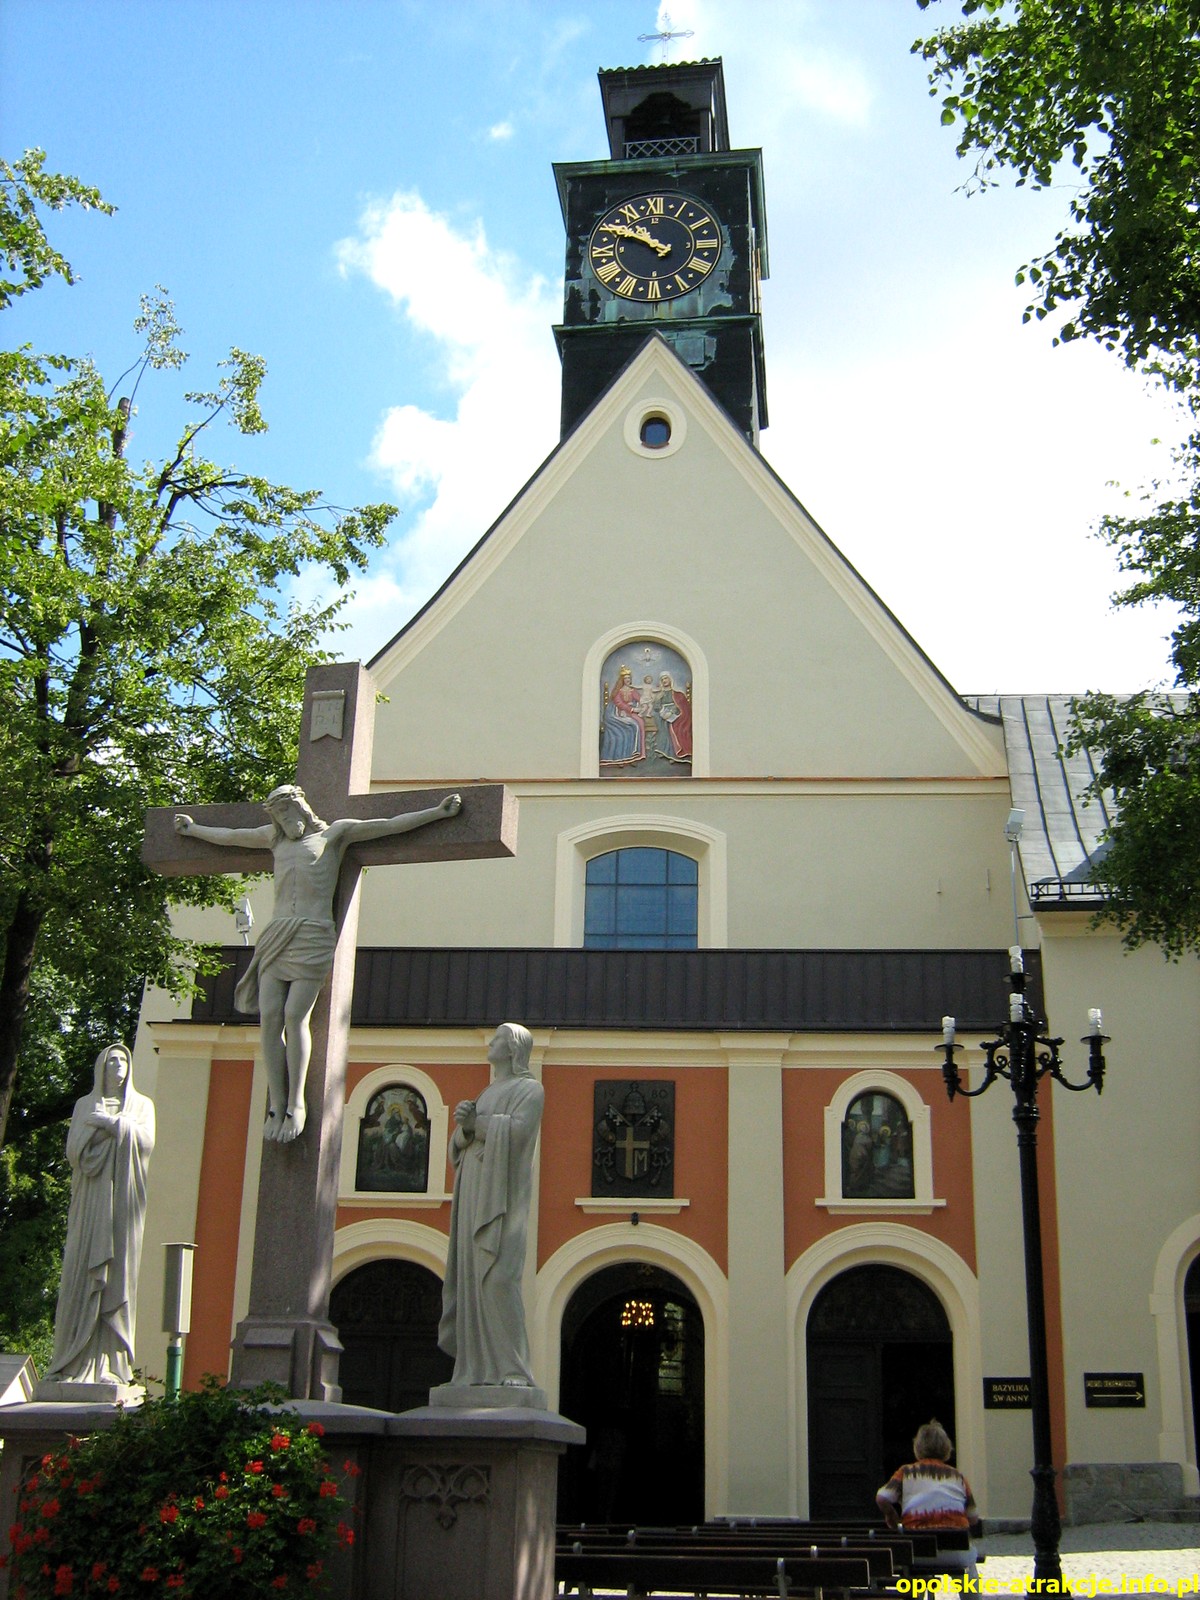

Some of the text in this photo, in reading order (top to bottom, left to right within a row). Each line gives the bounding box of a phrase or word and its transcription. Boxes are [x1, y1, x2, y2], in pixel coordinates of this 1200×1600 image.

[619, 203, 640, 224] XI
[646, 197, 664, 215] XII
[689, 216, 710, 231] II
[592, 243, 614, 258] IX
[696, 238, 717, 249] III
[596, 260, 621, 283] VIII
[616, 275, 638, 296] VII
[647, 280, 661, 299] VI
[674, 274, 690, 291] V
[634, 1150, 648, 1175] M
[992, 1384, 1029, 1392] BAZYLIKA
